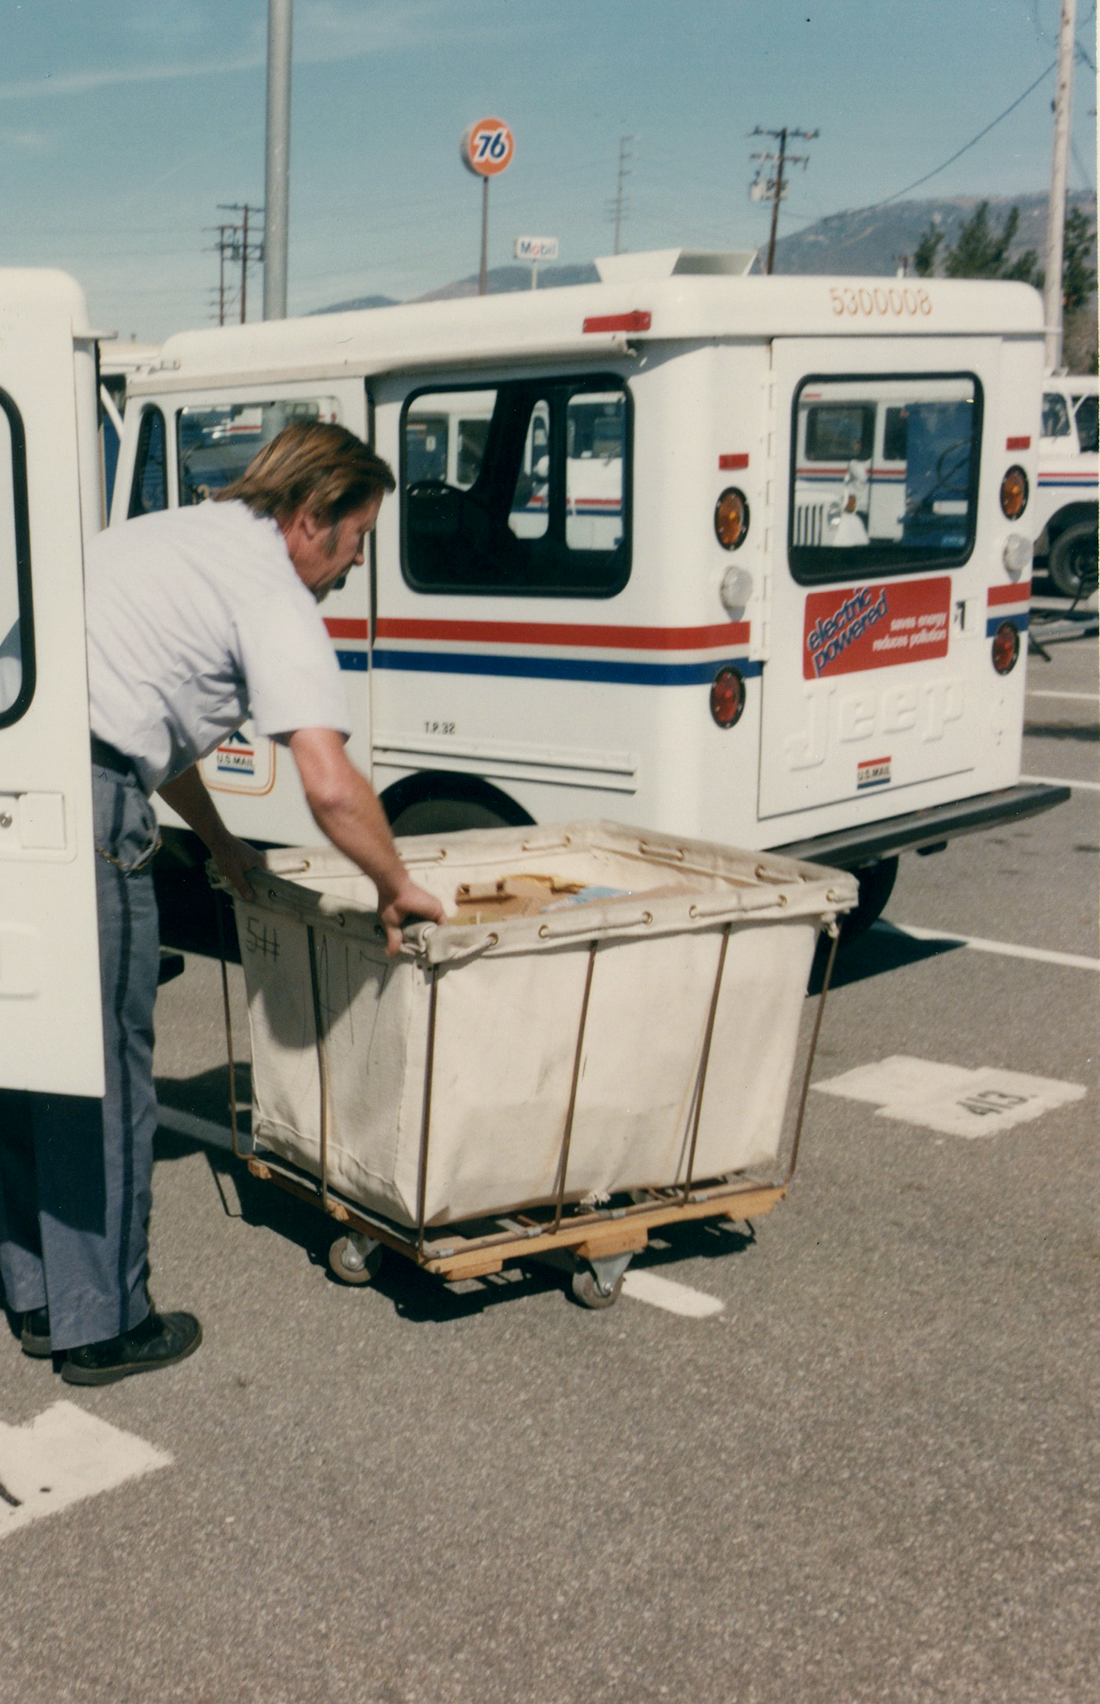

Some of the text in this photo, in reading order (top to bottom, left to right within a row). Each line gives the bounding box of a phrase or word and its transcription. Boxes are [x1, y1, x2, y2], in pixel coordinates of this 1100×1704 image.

[475, 129, 508, 161] 76
[830, 287, 932, 315] 5300008
[807, 586, 872, 652] electric
[812, 588, 888, 678] powered
[784, 680, 964, 772] Jeep
[956, 1090, 1029, 1116] 413
